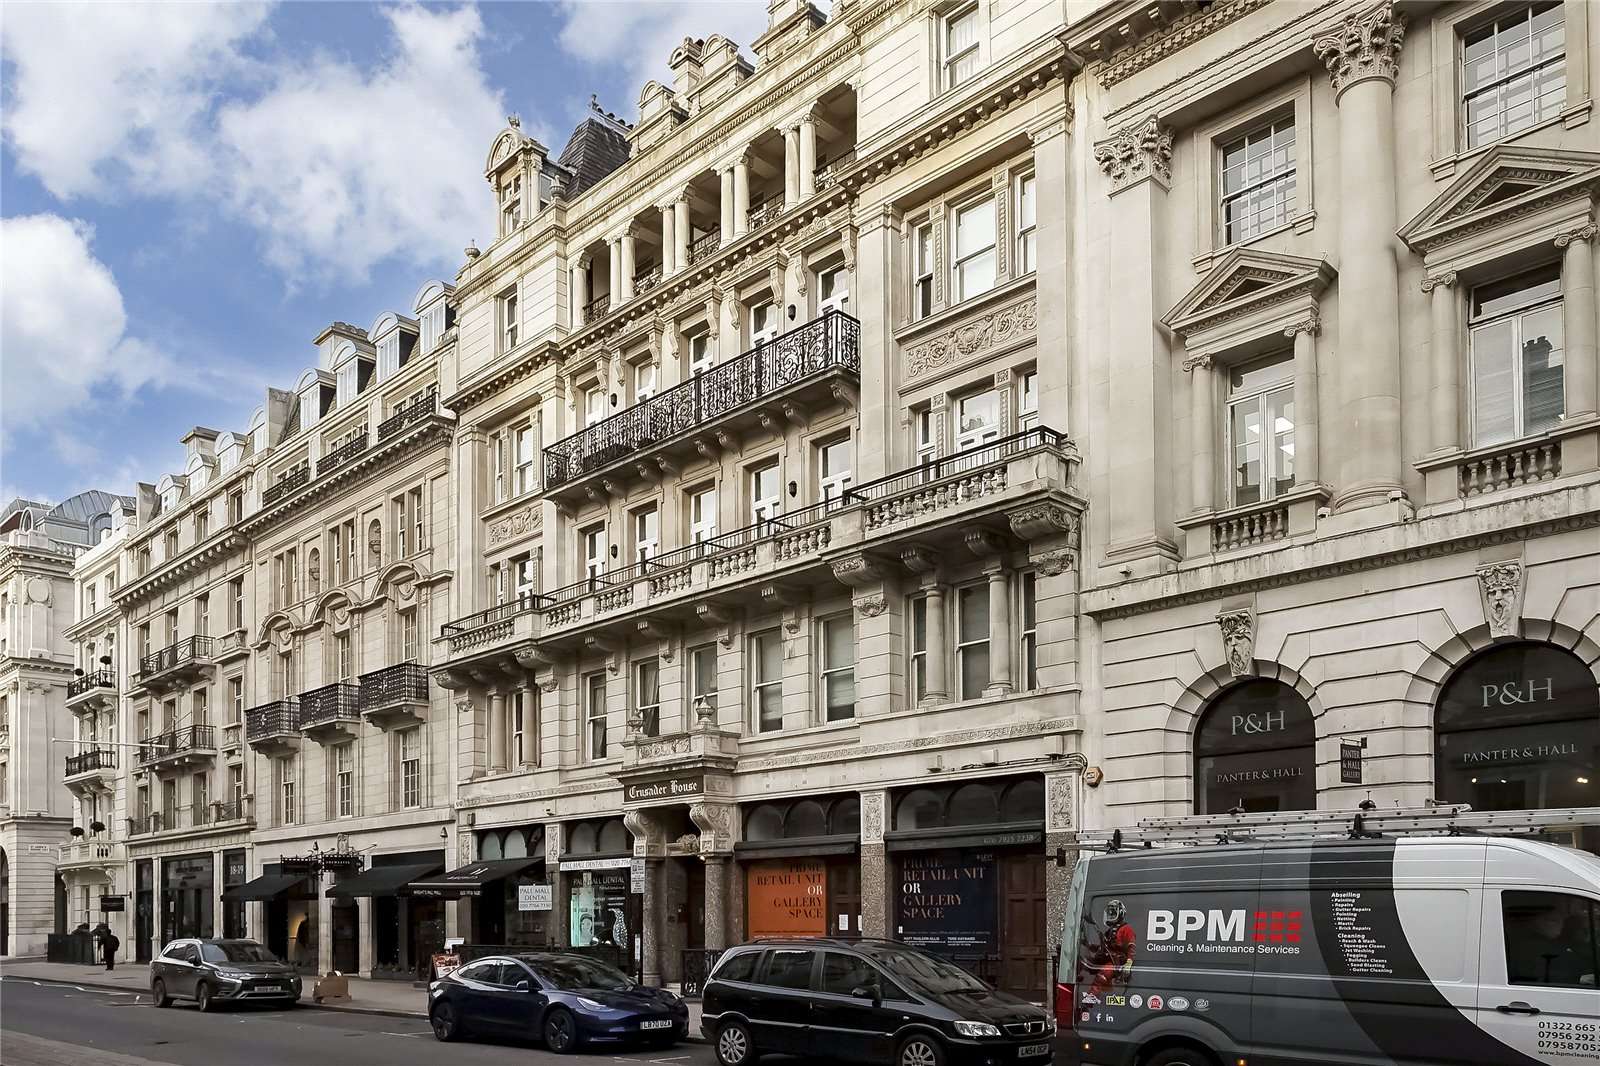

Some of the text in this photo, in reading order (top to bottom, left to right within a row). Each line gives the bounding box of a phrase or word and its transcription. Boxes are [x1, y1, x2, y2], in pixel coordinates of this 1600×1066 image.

[1481, 678, 1556, 707] P&H
[1232, 710, 1285, 735] P&H
[1343, 749, 1360, 759] PANTER
[1464, 744, 1578, 762] PANTER & HALL
[1347, 761, 1360, 770] HALL
[1217, 768, 1303, 783] PANTER & HALL
[629, 780, 697, 798] Crusader House
[904, 867, 986, 880] RETAIL UNIT
[757, 874, 795, 885] RETAIL
[807, 885, 822, 895] OR
[903, 883, 920, 893] OR
[774, 897, 822, 907] GALLERY
[904, 895, 961, 905] GALLERY
[789, 909, 822, 919] SPACE
[904, 908, 944, 918] SPACE
[1147, 909, 1246, 941] BPM
[1147, 943, 1184, 953] Cleaning
[1197, 944, 1255, 953] Maintenance
[1257, 945, 1300, 954] Services
[1107, 995, 1124, 1004] IPAF
[1539, 1021, 1572, 1030] 01322
[1538, 1031, 1572, 1040] 07956
[1575, 1033, 1595, 1041] 292
